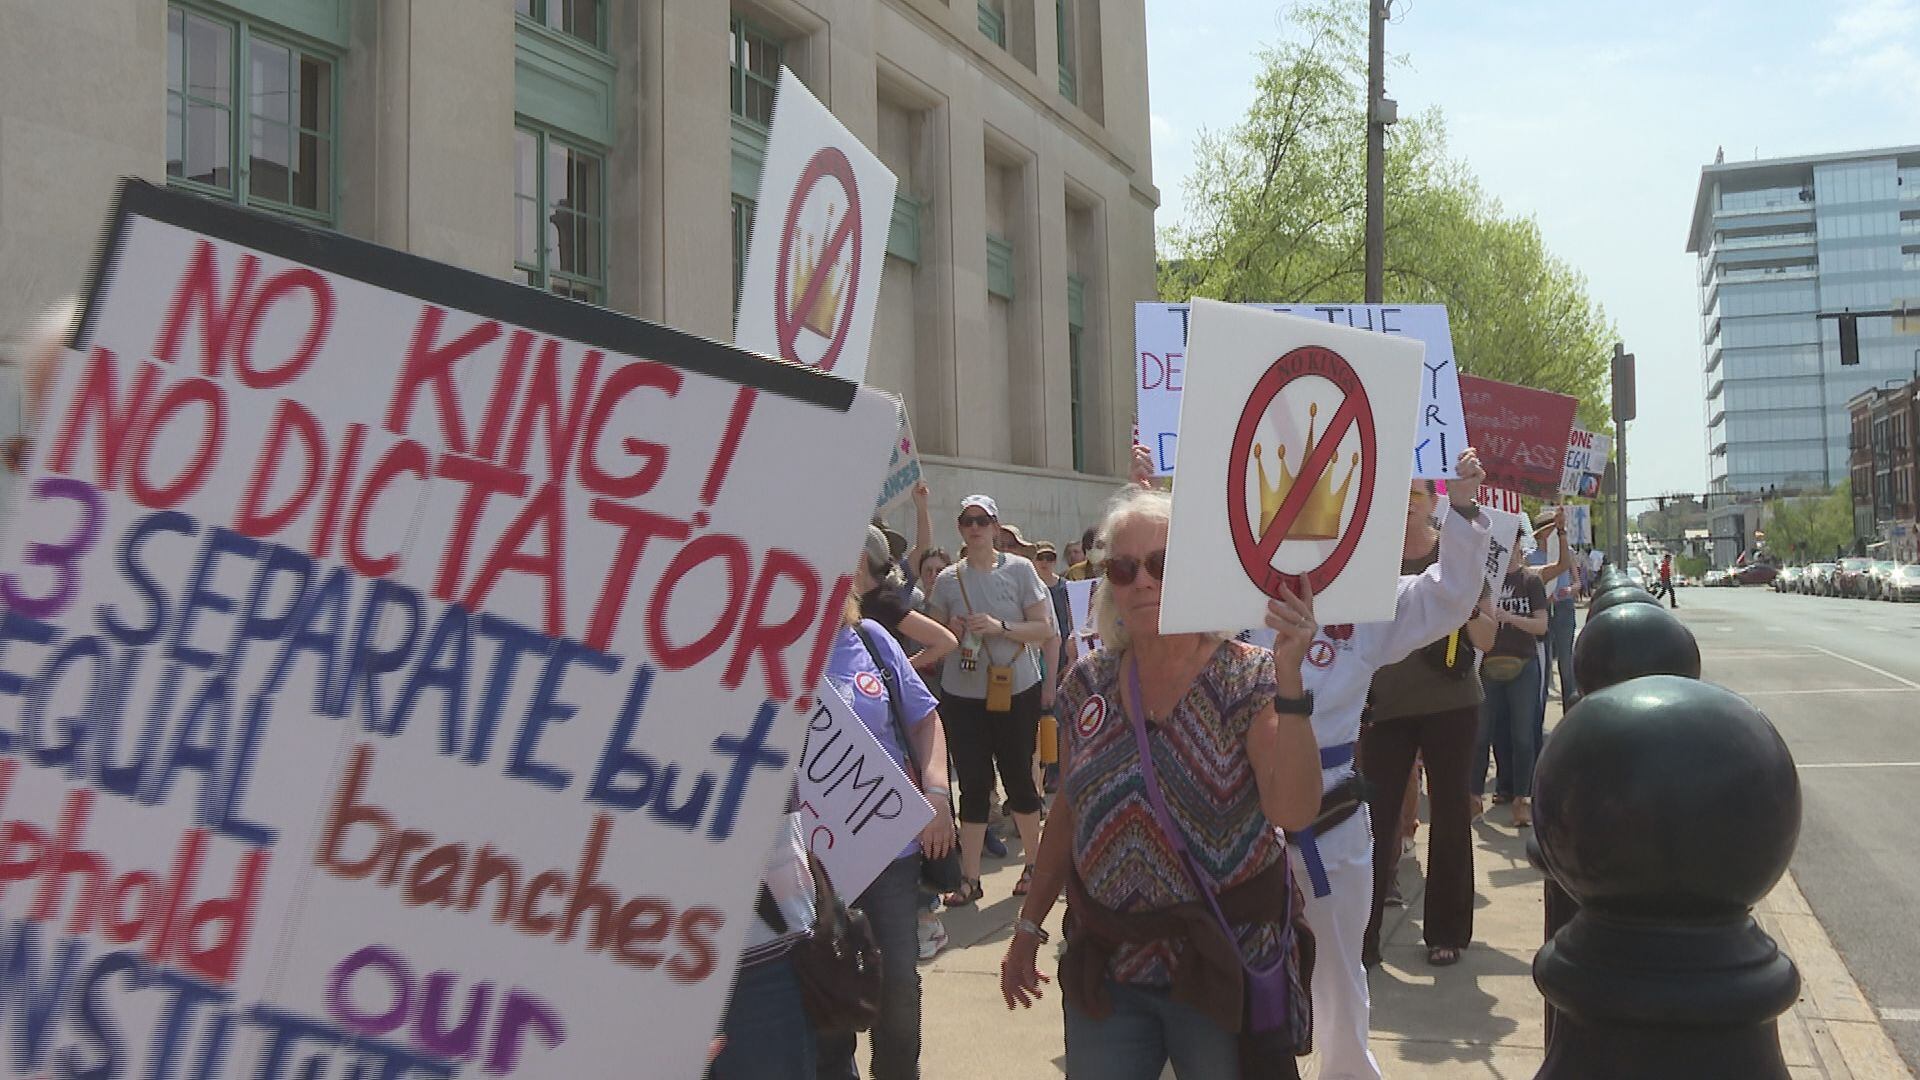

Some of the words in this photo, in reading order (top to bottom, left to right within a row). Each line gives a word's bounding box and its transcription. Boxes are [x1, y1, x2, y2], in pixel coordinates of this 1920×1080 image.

[154, 240, 336, 390] NO
[1480, 432, 1512, 458] MY
[1512, 442, 1558, 470] ASS
[0, 478, 108, 622] 3
[104, 510, 625, 790] SEPARATE
[589, 662, 790, 840] but
[53, 347, 228, 510] NO
[232, 398, 855, 713] DICTATOR!
[0, 609, 280, 847] EQUAL
[322, 741, 728, 983] branches
[0, 757, 272, 985] phold
[330, 943, 567, 1075] our
[799, 696, 904, 836] RUMP
